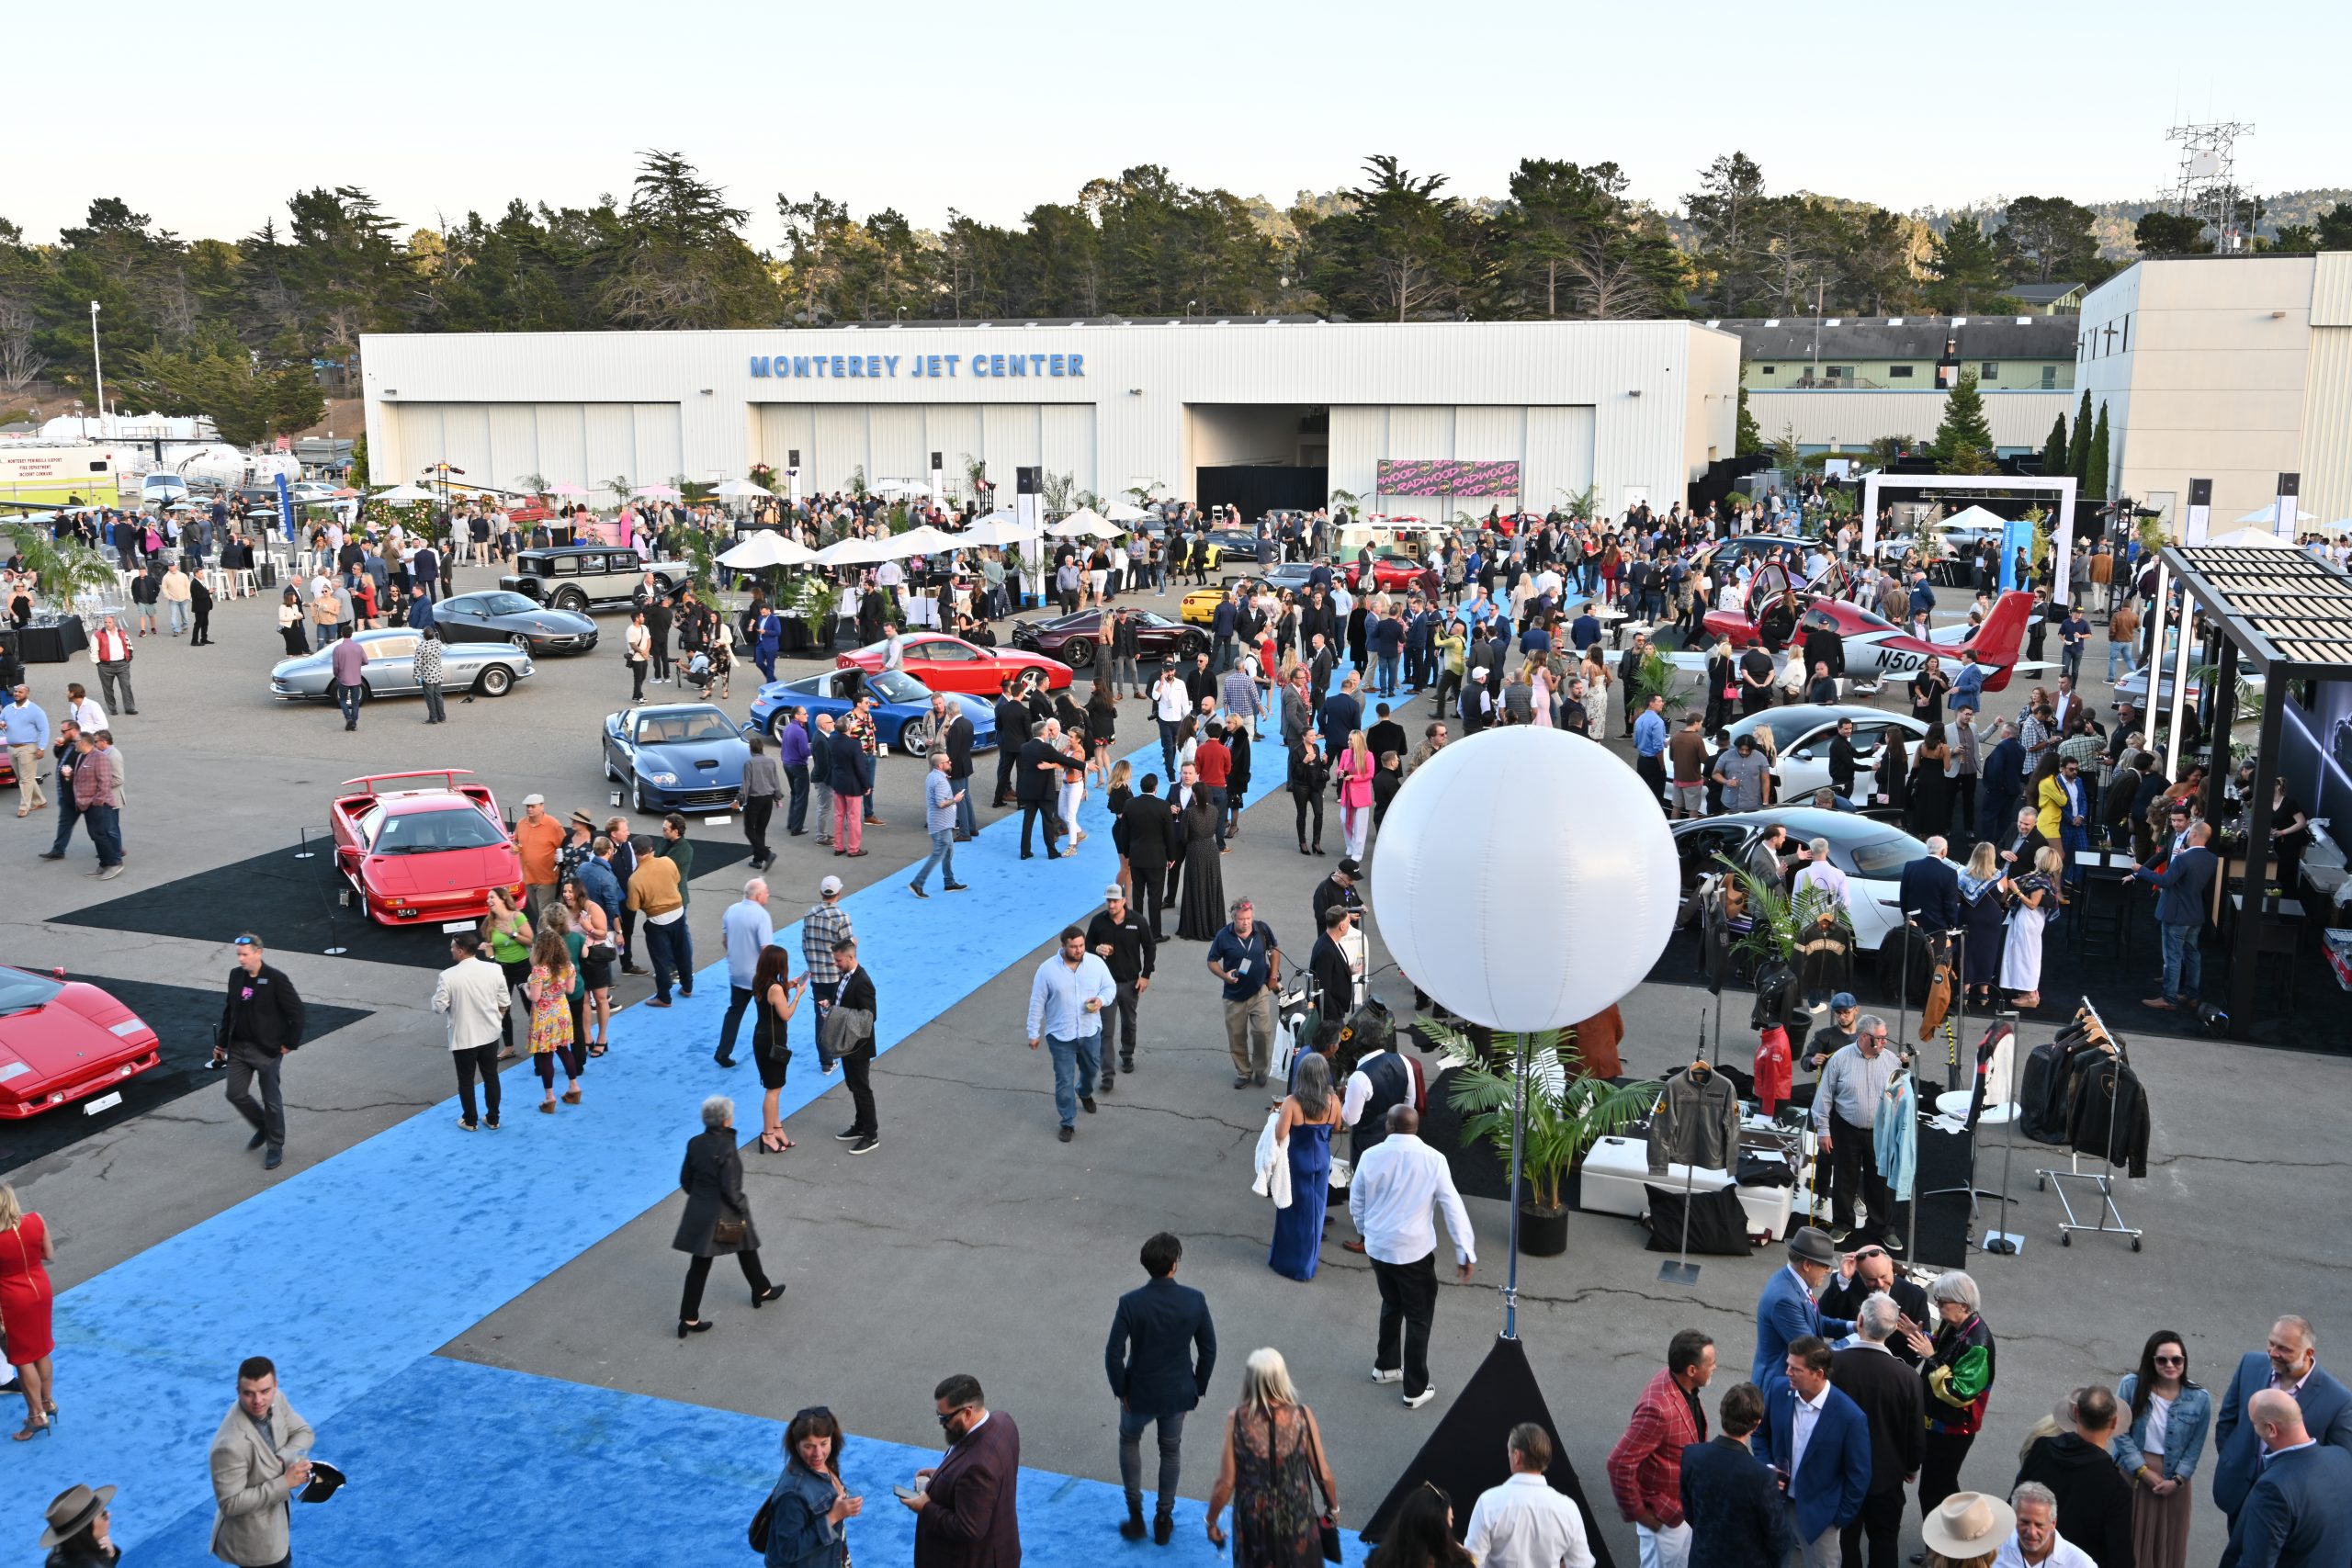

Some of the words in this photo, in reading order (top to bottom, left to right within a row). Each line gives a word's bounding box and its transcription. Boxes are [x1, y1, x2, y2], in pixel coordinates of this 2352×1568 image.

[751, 355, 901, 378] MONTEREY
[912, 355, 960, 378] JET
[972, 354, 1085, 377] CENTER
[1396, 467, 1459, 492] RADWOOD
[1453, 463, 1515, 488] RADWOOD
